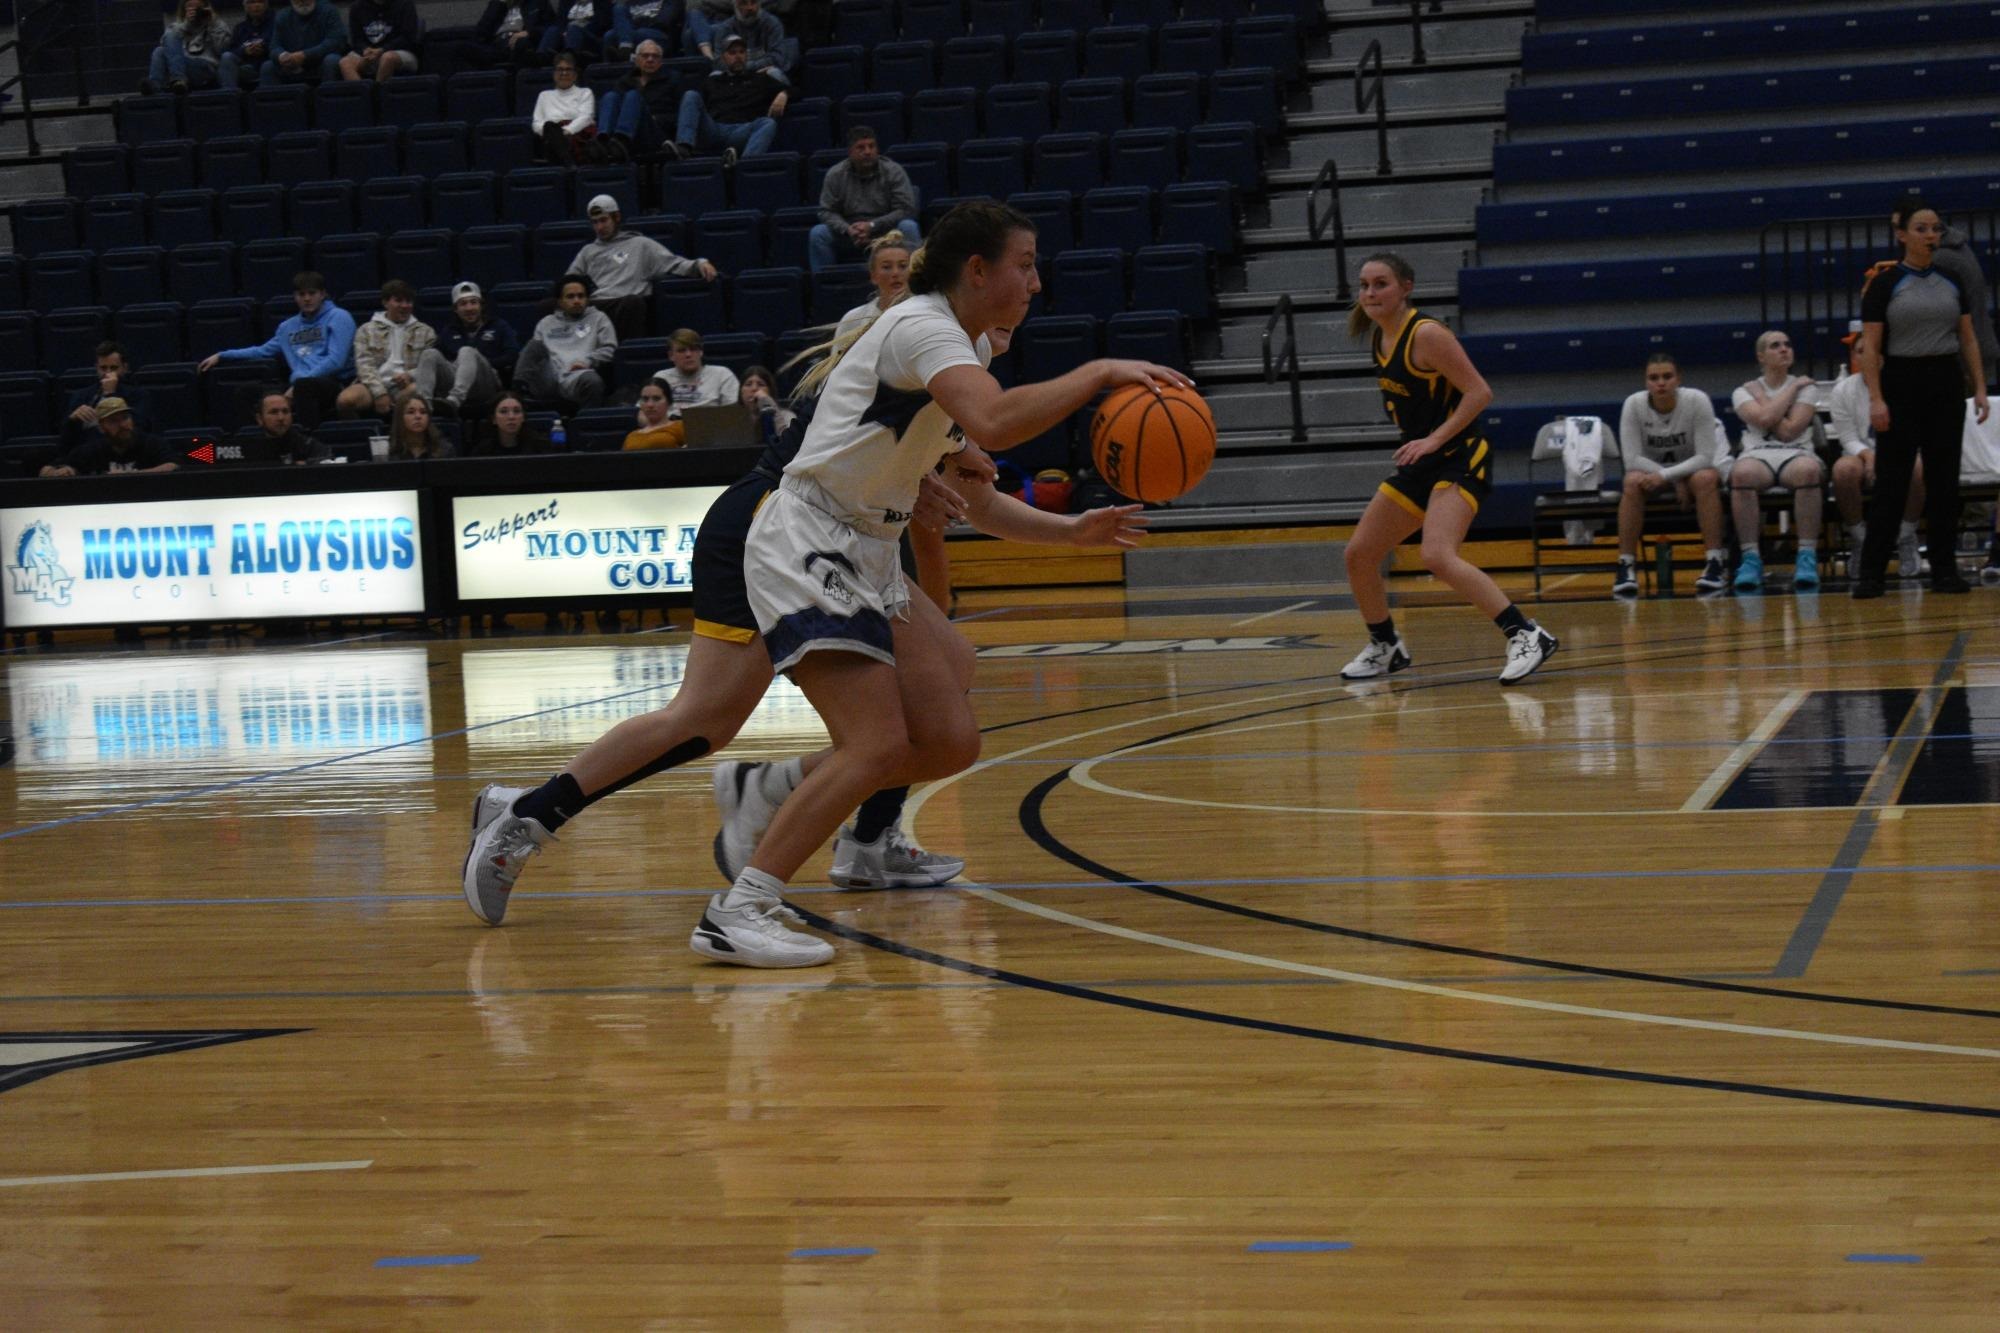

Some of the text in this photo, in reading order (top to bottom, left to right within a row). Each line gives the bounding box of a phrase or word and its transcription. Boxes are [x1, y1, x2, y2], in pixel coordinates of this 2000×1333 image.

[462, 499, 559, 551] Support
[525, 526, 667, 560] MOUNT
[81, 516, 416, 581] MOUNT ALOYSIUS
[7, 564, 75, 606] MAC
[132, 577, 368, 600] COLLEGE
[608, 559, 693, 589] COL
